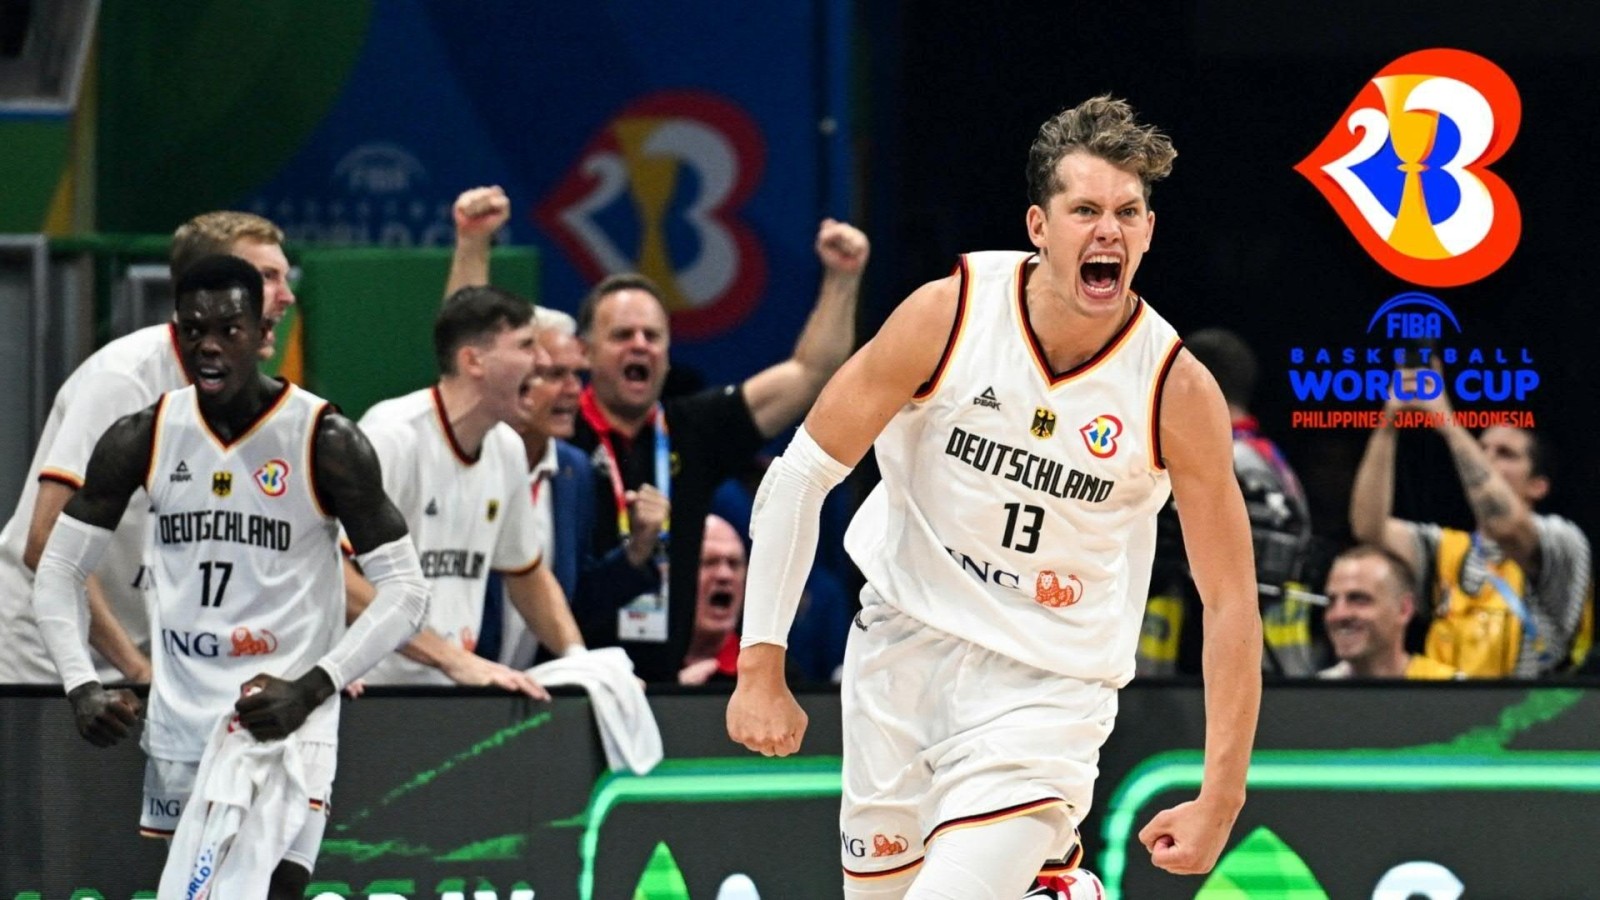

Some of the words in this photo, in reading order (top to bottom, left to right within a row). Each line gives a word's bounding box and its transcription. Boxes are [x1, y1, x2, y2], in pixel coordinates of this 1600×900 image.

[945, 427, 1114, 502] DEUTSCHLAND
[159, 510, 291, 551] DEUTSCHLAND
[1001, 502, 1045, 554] 13
[198, 561, 233, 607] 17
[161, 629, 219, 658] ING
[150, 797, 180, 817] ING
